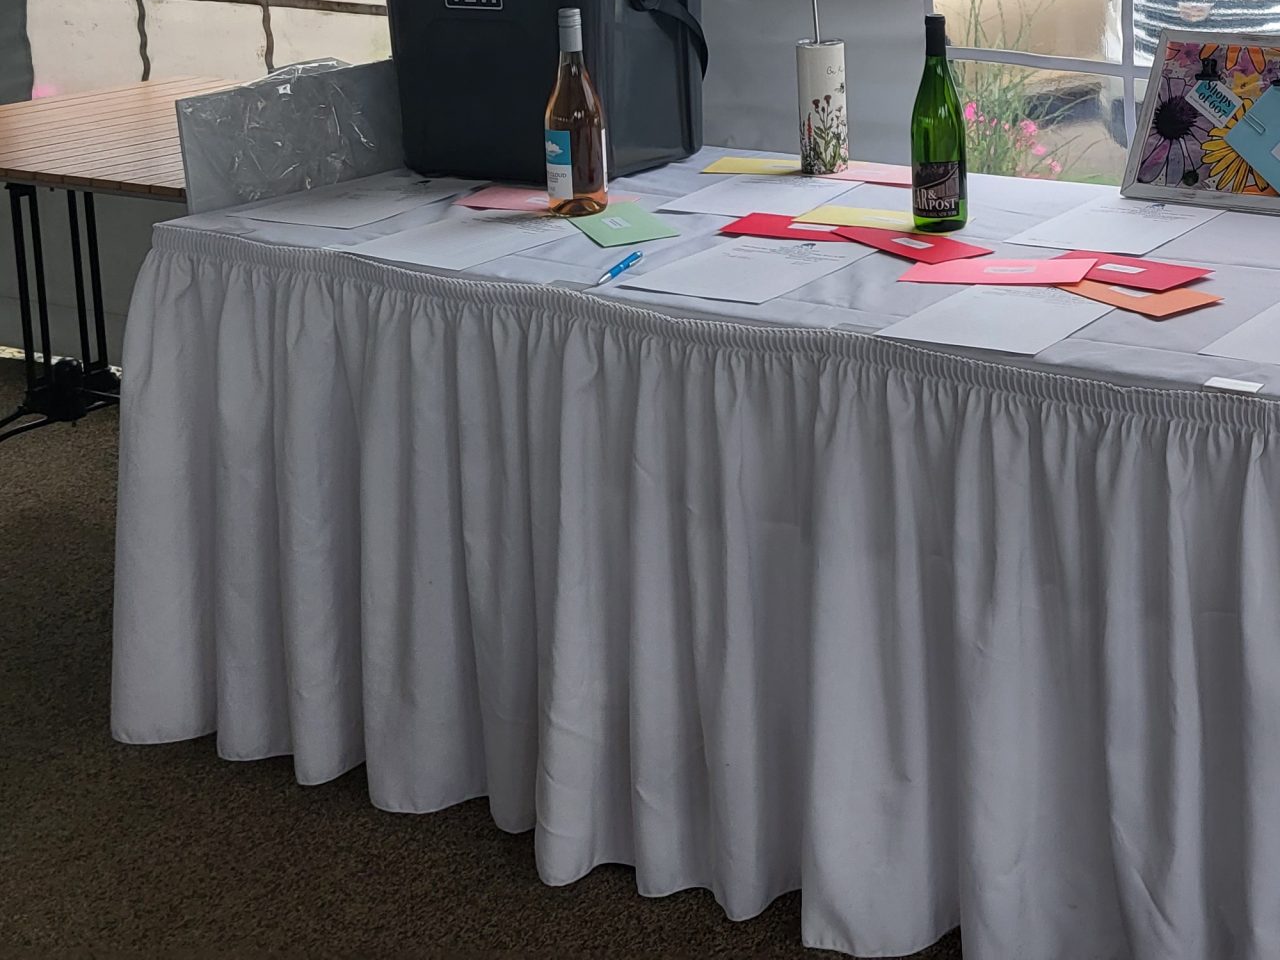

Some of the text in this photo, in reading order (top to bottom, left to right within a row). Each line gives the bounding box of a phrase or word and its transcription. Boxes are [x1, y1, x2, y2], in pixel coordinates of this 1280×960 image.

[1204, 81, 1232, 108] Shops
[1198, 92, 1227, 118] of 607
[928, 189, 937, 199] &
[929, 198, 957, 210] POST
